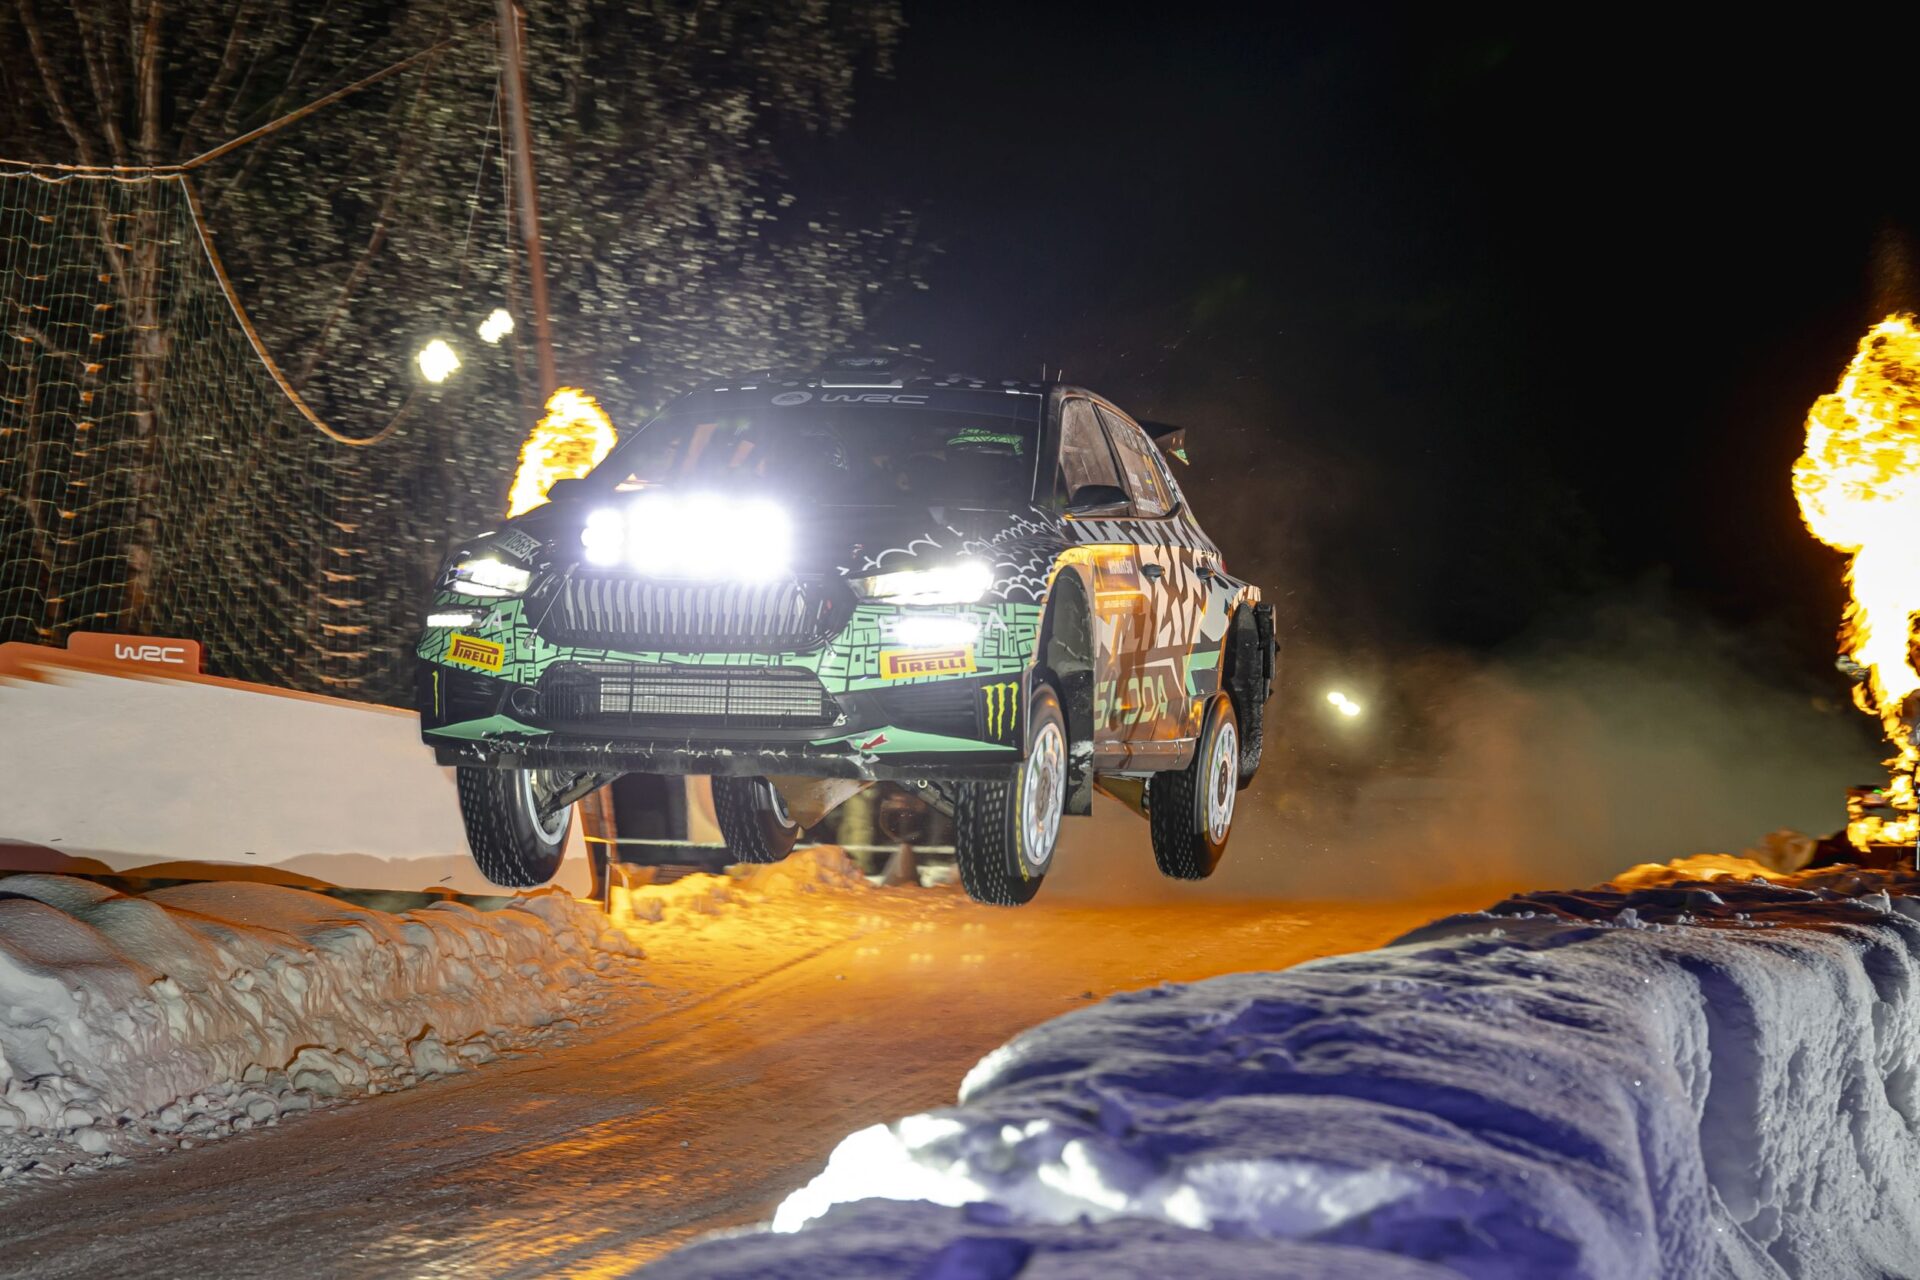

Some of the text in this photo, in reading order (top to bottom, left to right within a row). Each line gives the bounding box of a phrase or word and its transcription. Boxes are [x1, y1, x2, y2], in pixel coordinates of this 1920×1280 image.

[821, 393, 929, 405] WRC
[115, 643, 184, 663] WRC
[452, 639, 499, 666] PIRELLI
[889, 650, 967, 674] PIRELLI
